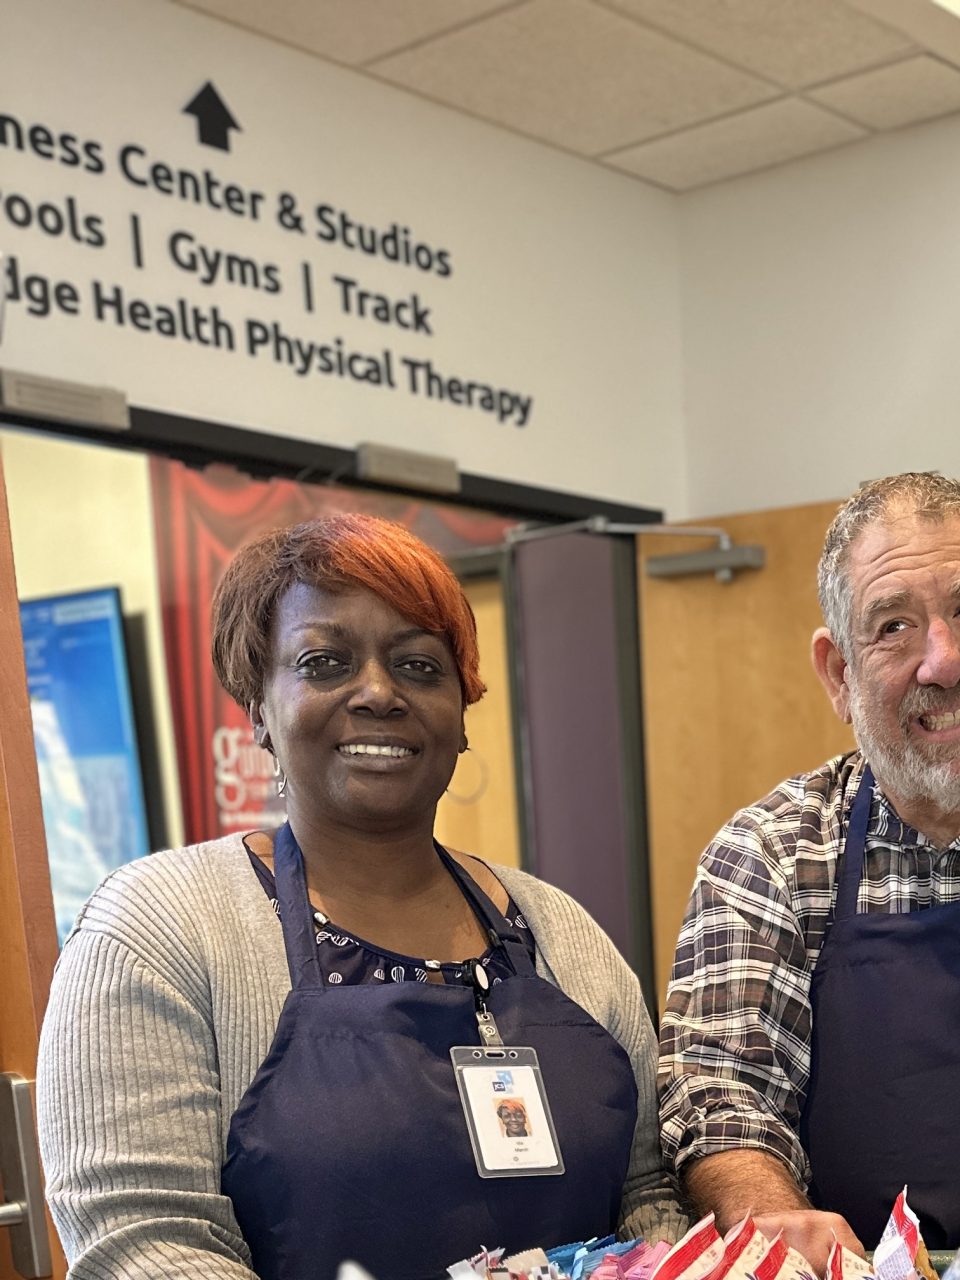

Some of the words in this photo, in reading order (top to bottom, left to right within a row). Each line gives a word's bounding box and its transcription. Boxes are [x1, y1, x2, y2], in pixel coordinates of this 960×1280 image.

[0, 195, 105, 247] ools
[169, 231, 281, 293] Gyms
[333, 274, 432, 334] Track
[119, 146, 265, 220] Center
[277, 193, 304, 232] &
[316, 205, 451, 277] Studios
[92, 281, 234, 351] Health
[247, 320, 396, 388] Physical
[403, 359, 533, 425] Therapy
